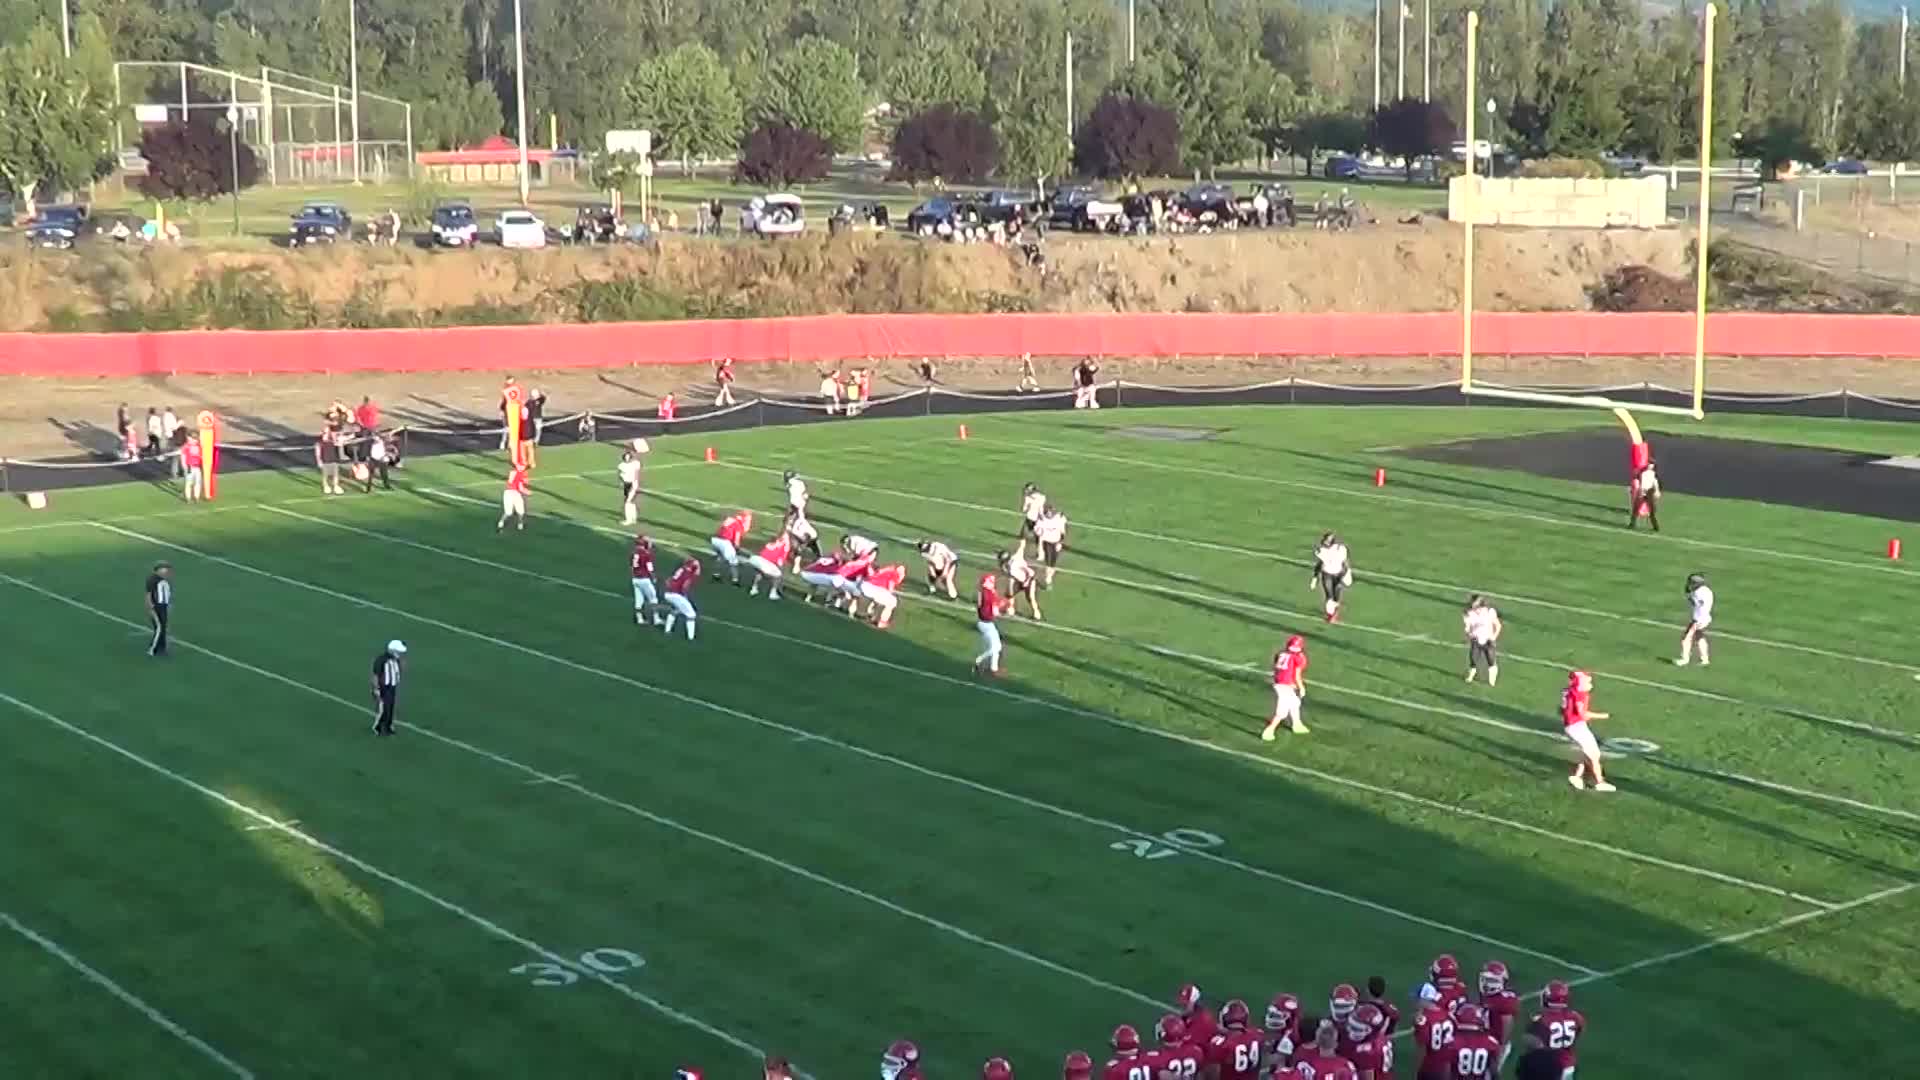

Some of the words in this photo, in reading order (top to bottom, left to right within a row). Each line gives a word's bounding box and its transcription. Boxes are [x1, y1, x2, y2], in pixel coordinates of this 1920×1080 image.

[1109, 828, 1225, 859] 20
[508, 948, 646, 986] 30
[1549, 1020, 1577, 1048] 25
[1234, 1040, 1260, 1072] 64
[1458, 1047, 1489, 1075] 80
